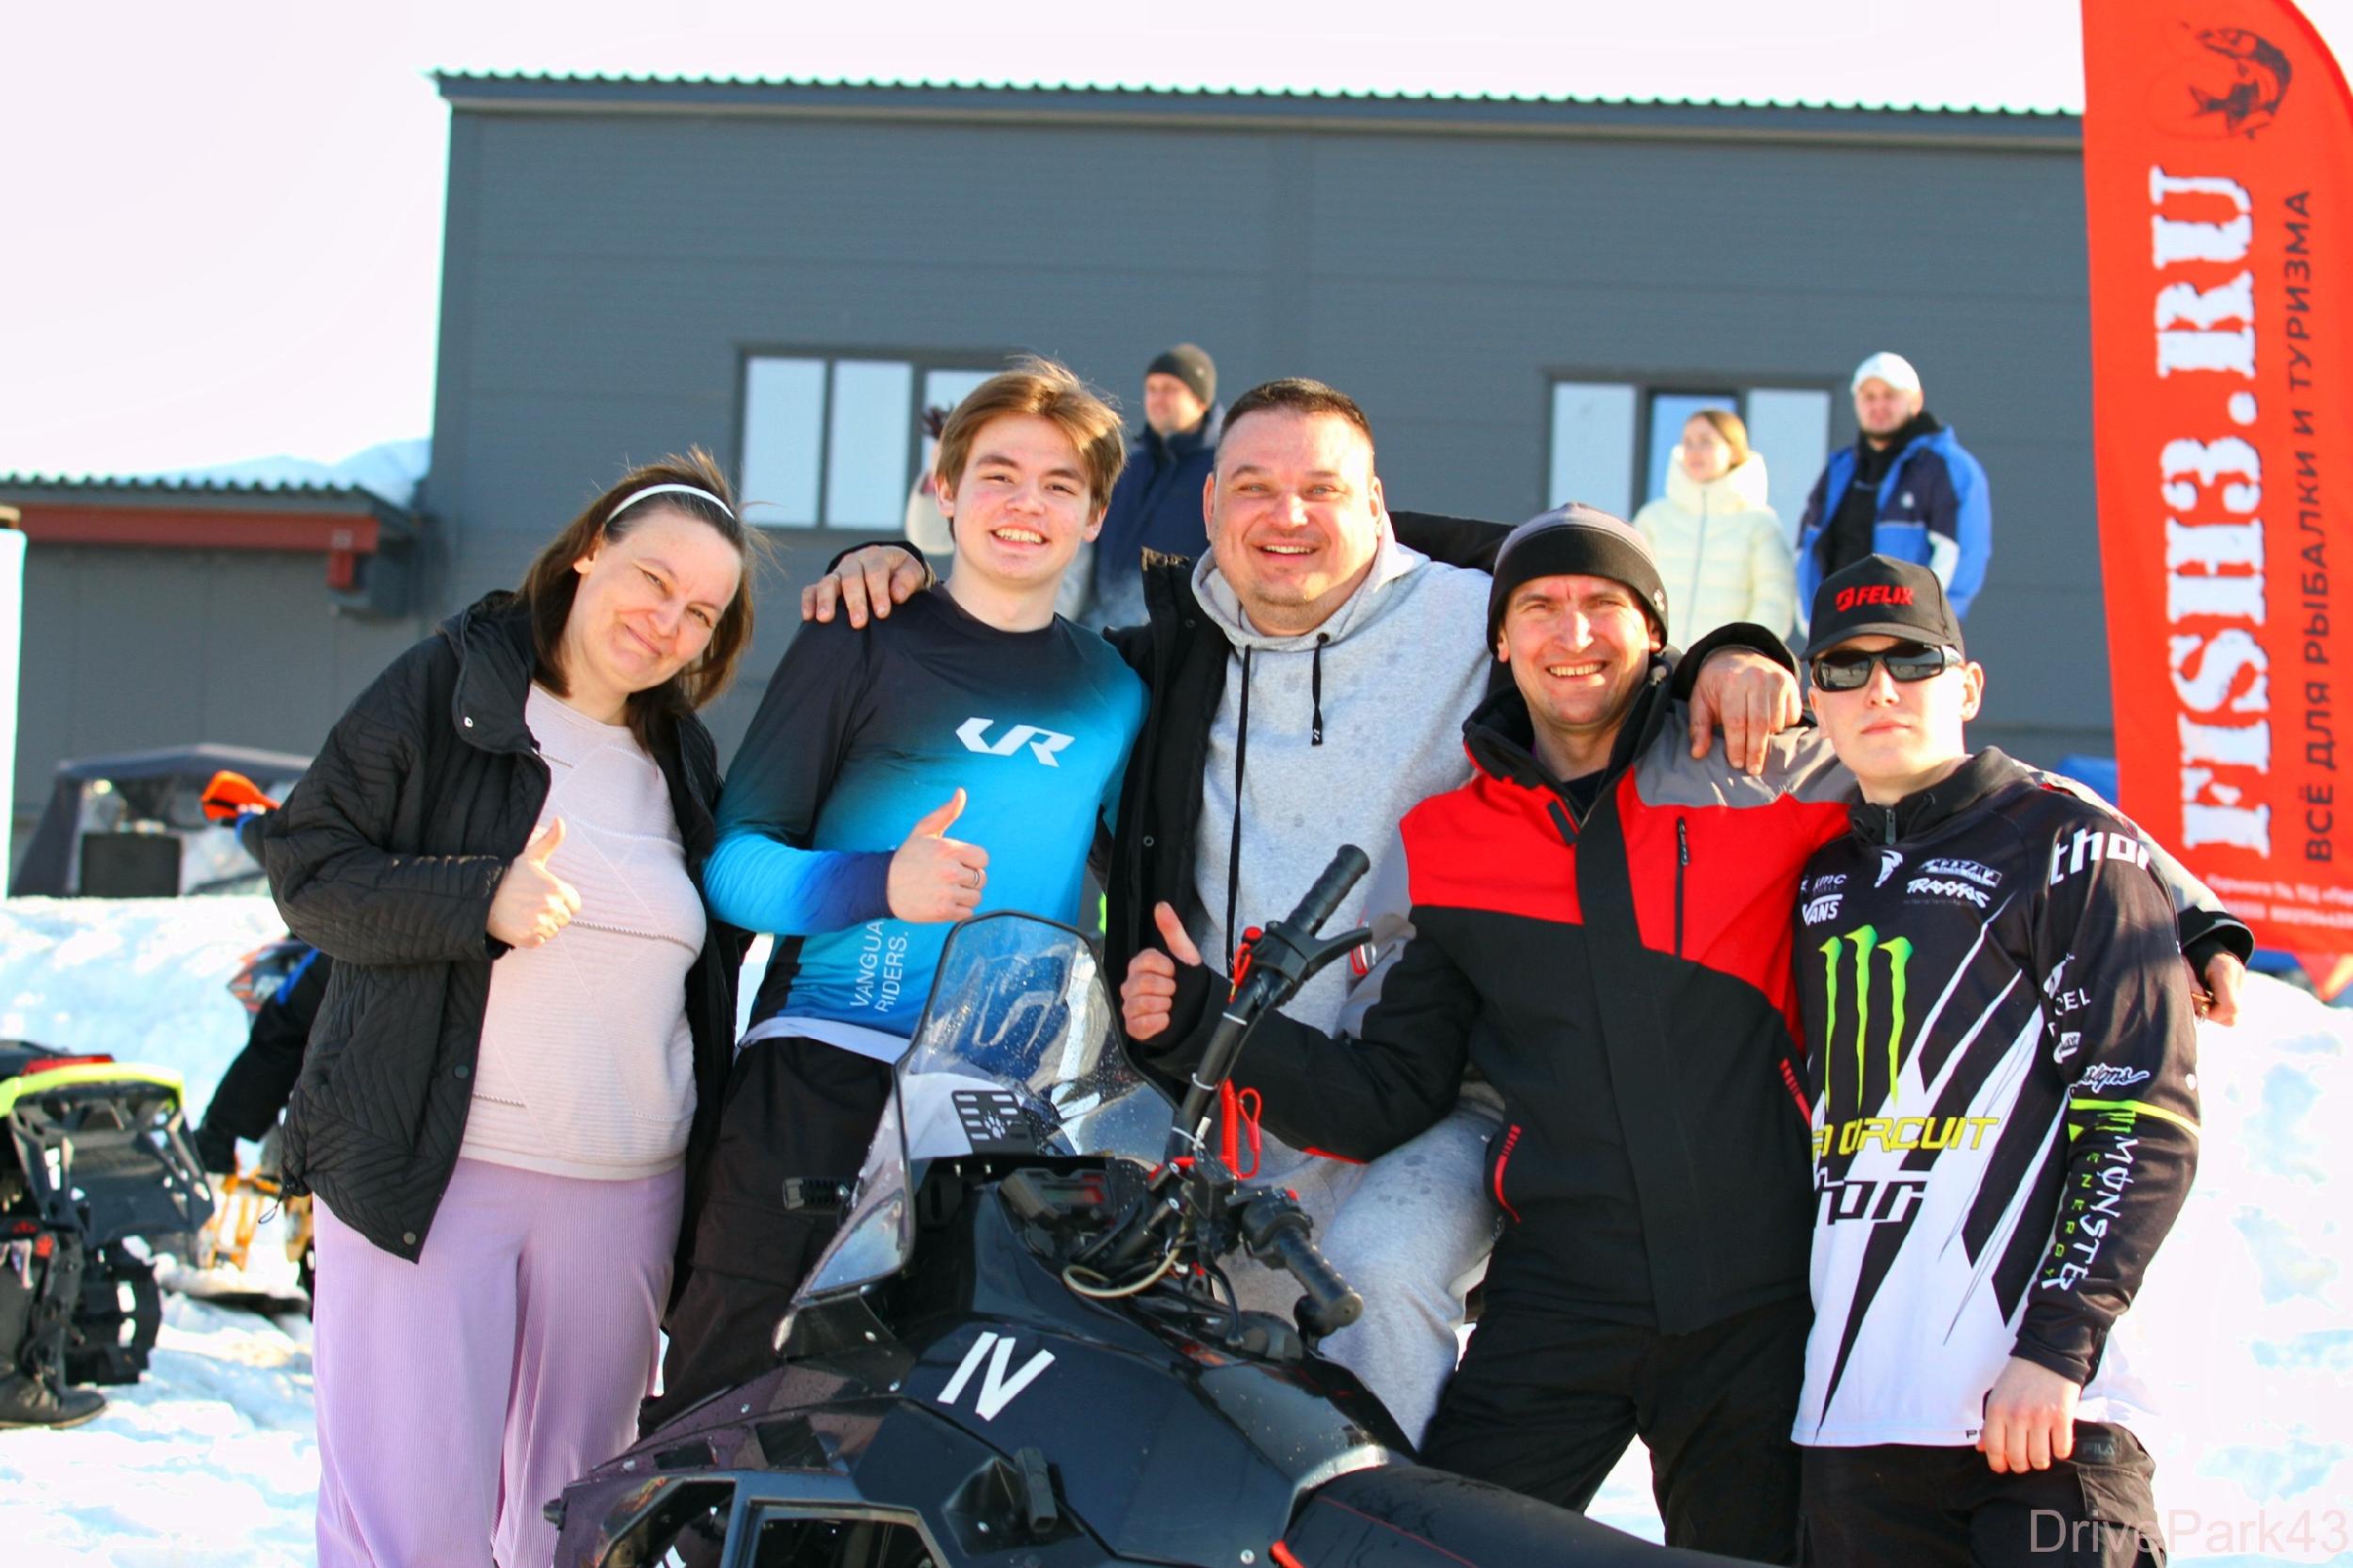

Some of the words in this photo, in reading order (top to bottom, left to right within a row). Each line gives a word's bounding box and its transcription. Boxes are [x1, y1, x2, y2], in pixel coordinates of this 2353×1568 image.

[2284, 190, 2313, 392] ТУРИЗМА
[2292, 408, 2314, 436] И
[2149, 164, 2270, 859] FISH3.RU
[1855, 584, 1914, 607] FELIX
[2294, 451, 2329, 665] РЫБАЛКИ
[2305, 680, 2336, 770] ДЛЯ
[2298, 783, 2334, 862] ВСЁ
[1801, 893, 1843, 926] VANS
[873, 931, 909, 1014] RIDERS.
[2081, 1442, 2116, 1456] FILA
